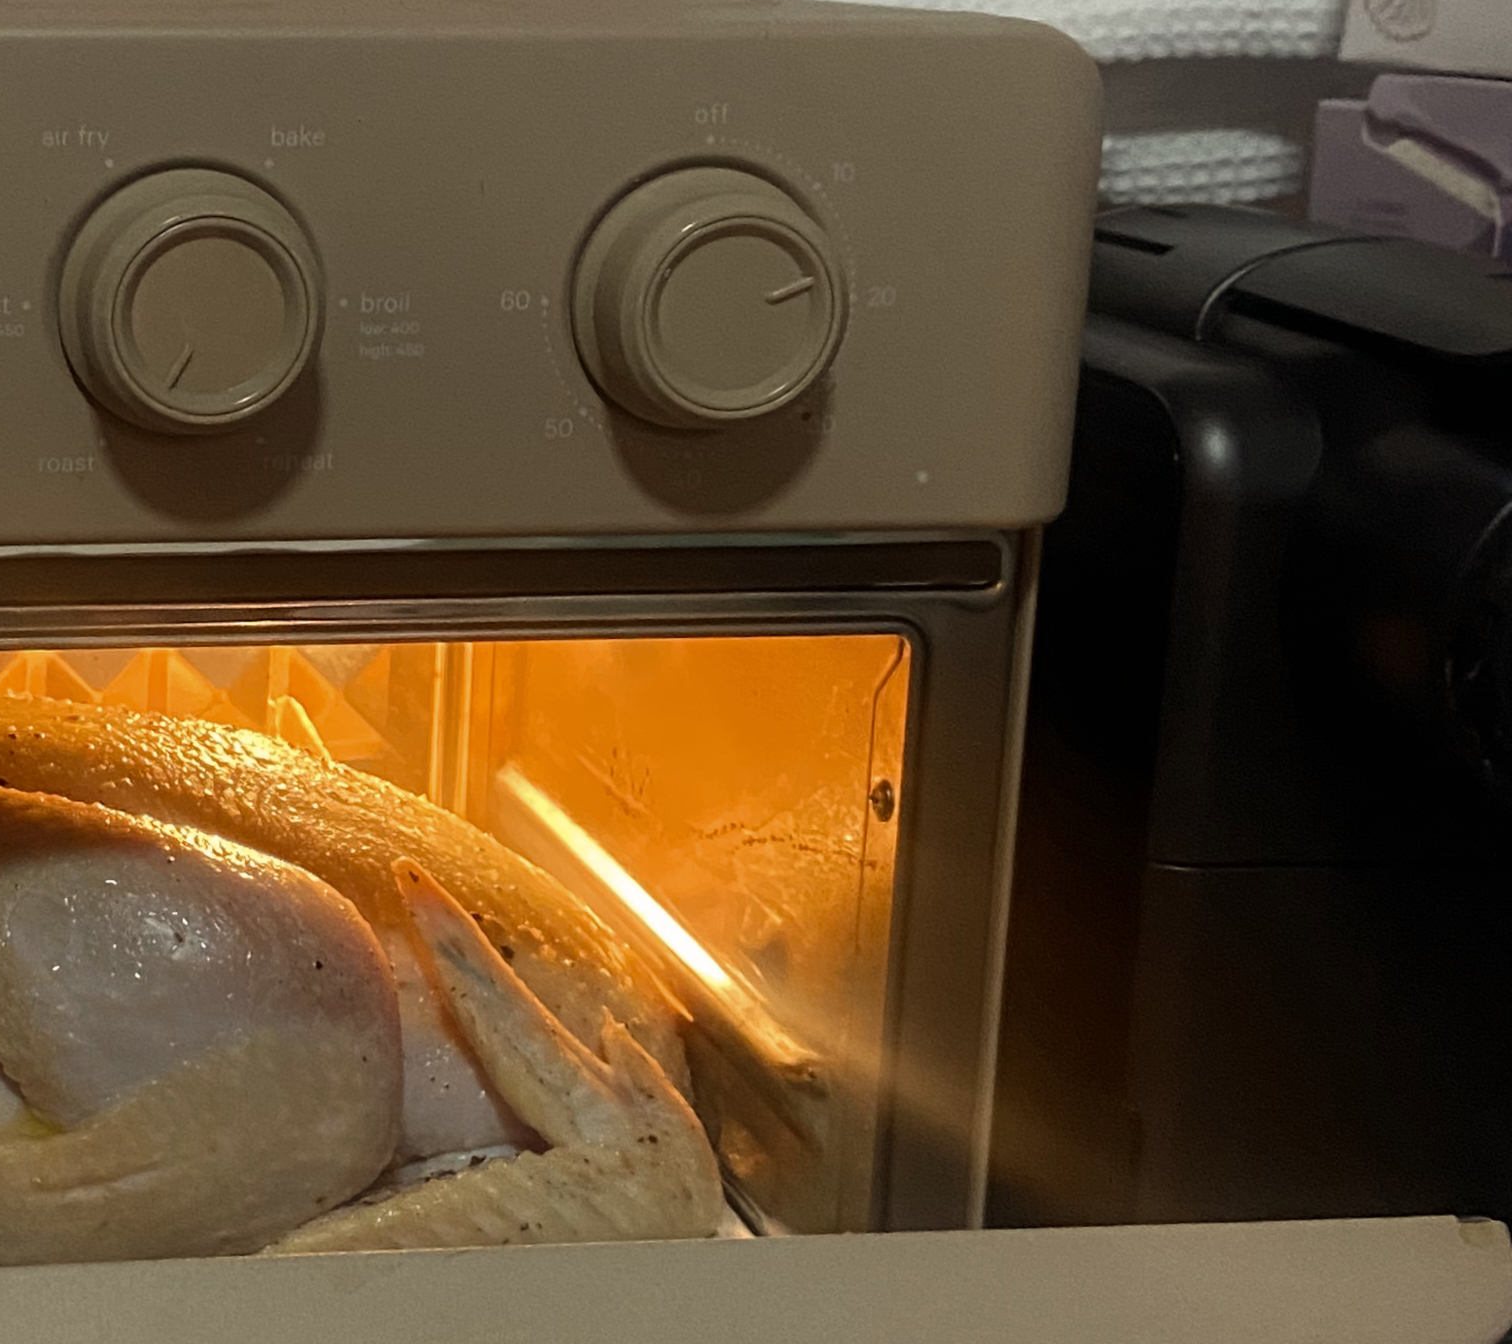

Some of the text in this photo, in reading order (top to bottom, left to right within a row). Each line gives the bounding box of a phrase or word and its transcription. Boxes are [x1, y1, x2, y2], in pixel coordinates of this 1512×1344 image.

[694, 103, 730, 126] off
[41, 124, 110, 152] air fry
[270, 124, 326, 148] bake
[831, 162, 856, 182] 10
[360, 290, 411, 314] broil
[500, 290, 530, 311] 60
[867, 286, 897, 308] 20
[543, 418, 574, 439] 50
[37, 452, 95, 473] roast
